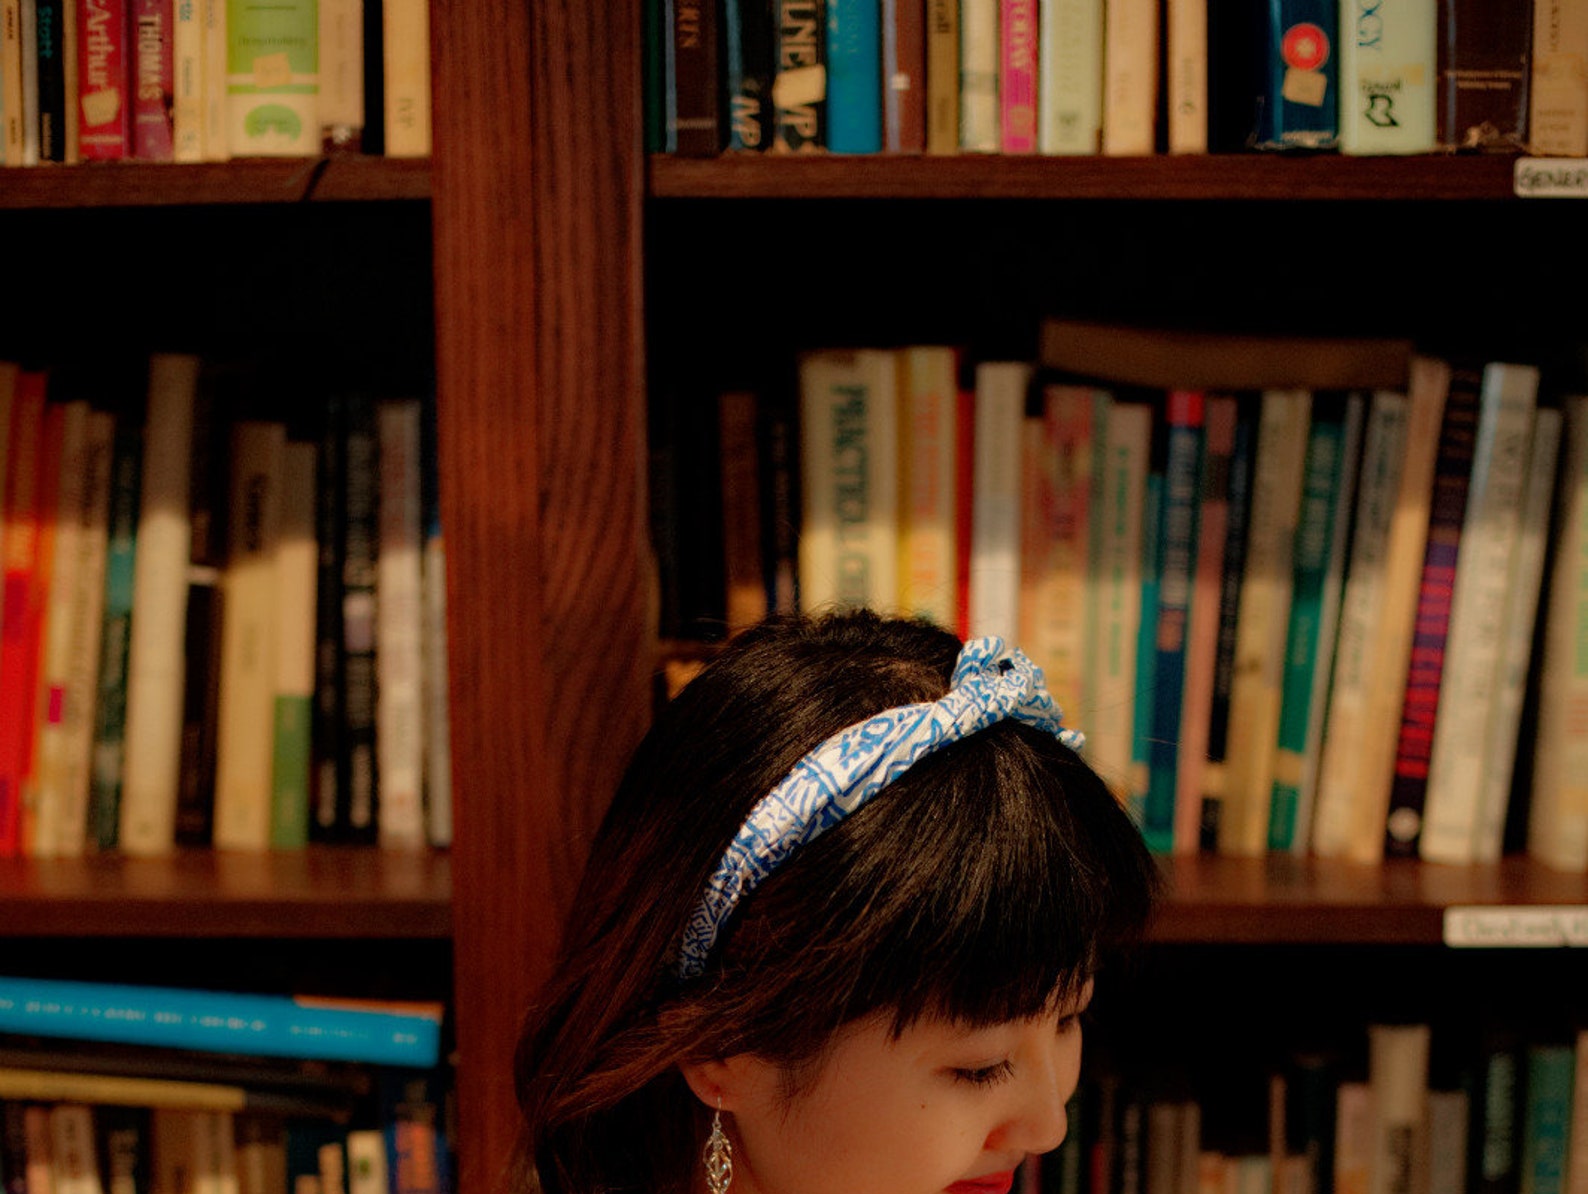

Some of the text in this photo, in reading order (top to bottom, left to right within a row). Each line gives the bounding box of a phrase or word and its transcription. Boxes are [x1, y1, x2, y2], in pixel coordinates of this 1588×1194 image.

[38, 6, 53, 59] Stott
[138, 13, 163, 100] THOMAS
[731, 96, 761, 147] IVP
